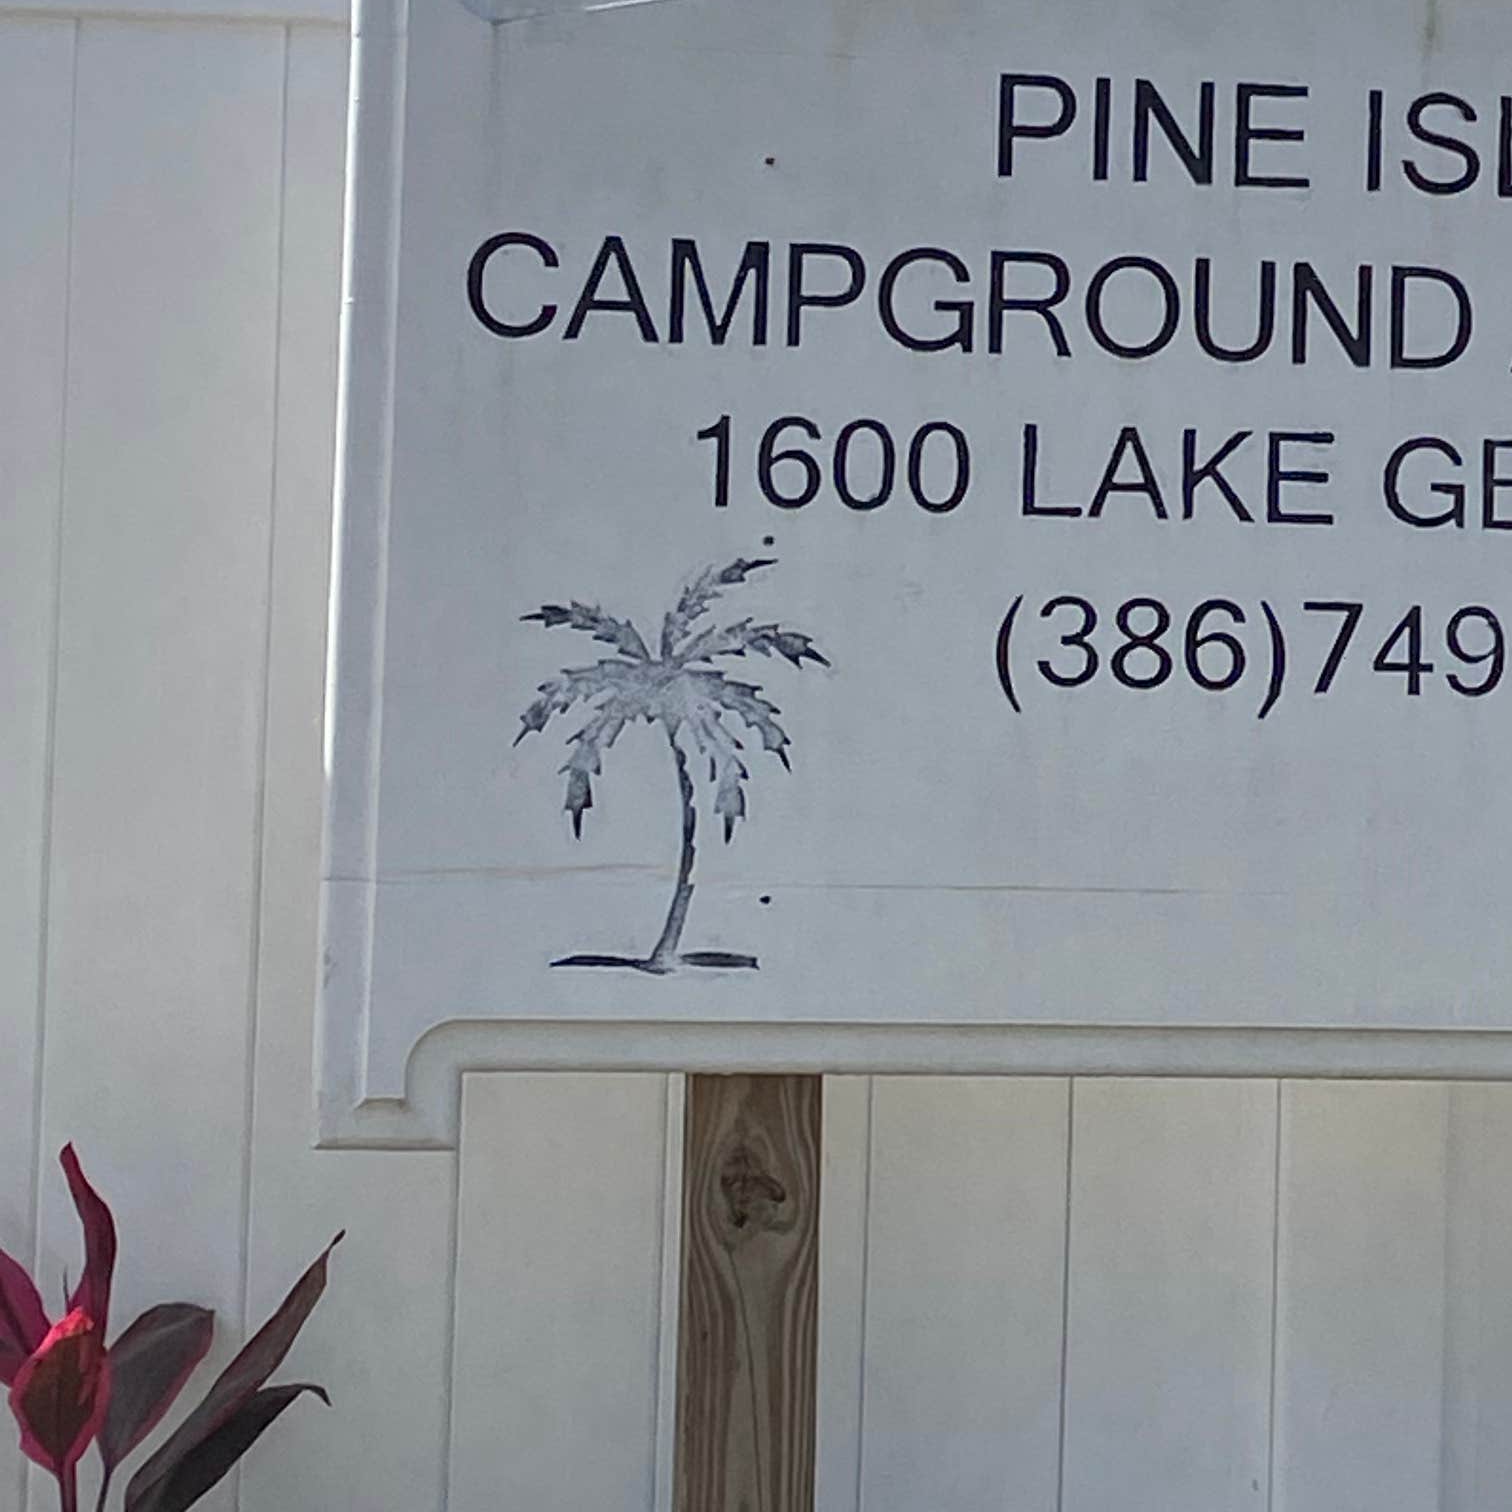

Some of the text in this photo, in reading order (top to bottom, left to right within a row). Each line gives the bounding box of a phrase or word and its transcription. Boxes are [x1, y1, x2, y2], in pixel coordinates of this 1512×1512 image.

[996, 71, 1312, 189] PINE
[465, 230, 1474, 371] CAMPGROUND
[695, 413, 972, 515] 1600
[1020, 422, 1337, 527] LAKE
